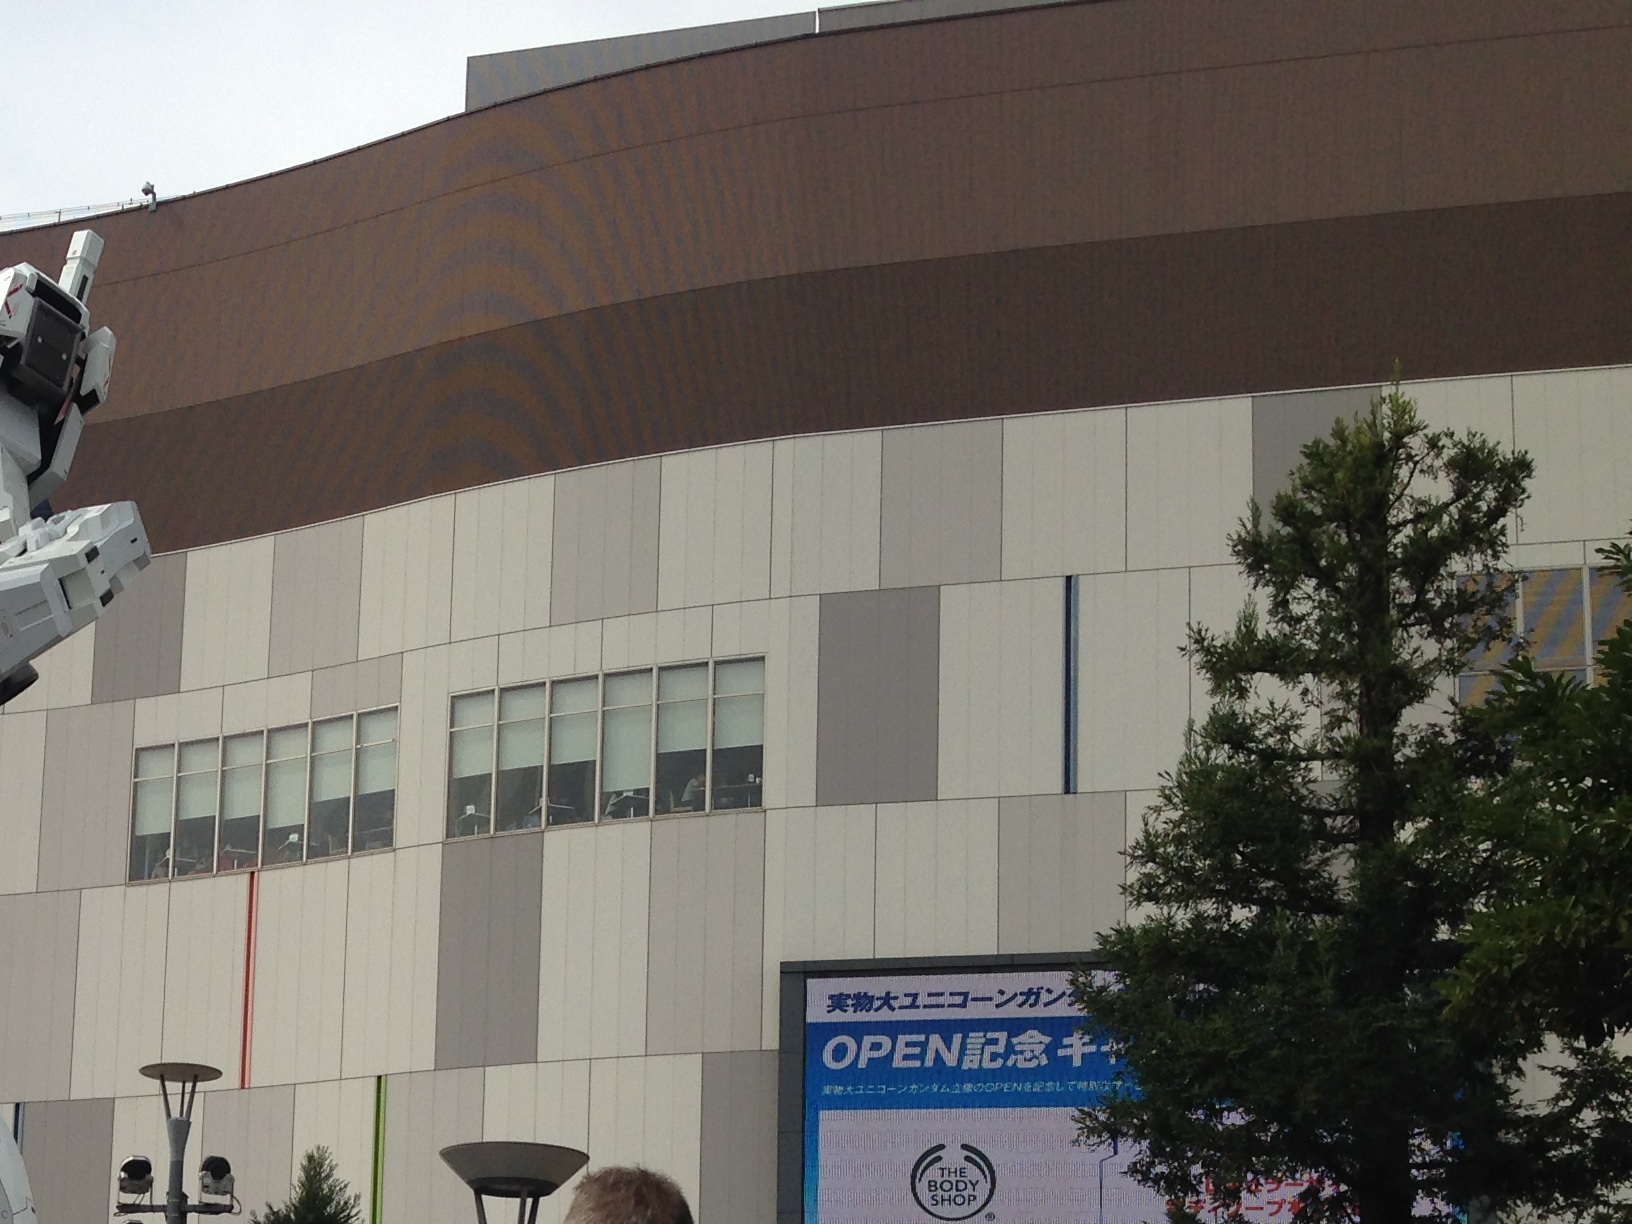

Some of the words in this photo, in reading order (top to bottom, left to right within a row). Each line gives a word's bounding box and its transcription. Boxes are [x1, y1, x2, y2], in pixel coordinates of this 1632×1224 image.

[938, 1167, 967, 1178] THE
[928, 1180, 979, 1192] BODY
[931, 1194, 977, 1206] SHOP
